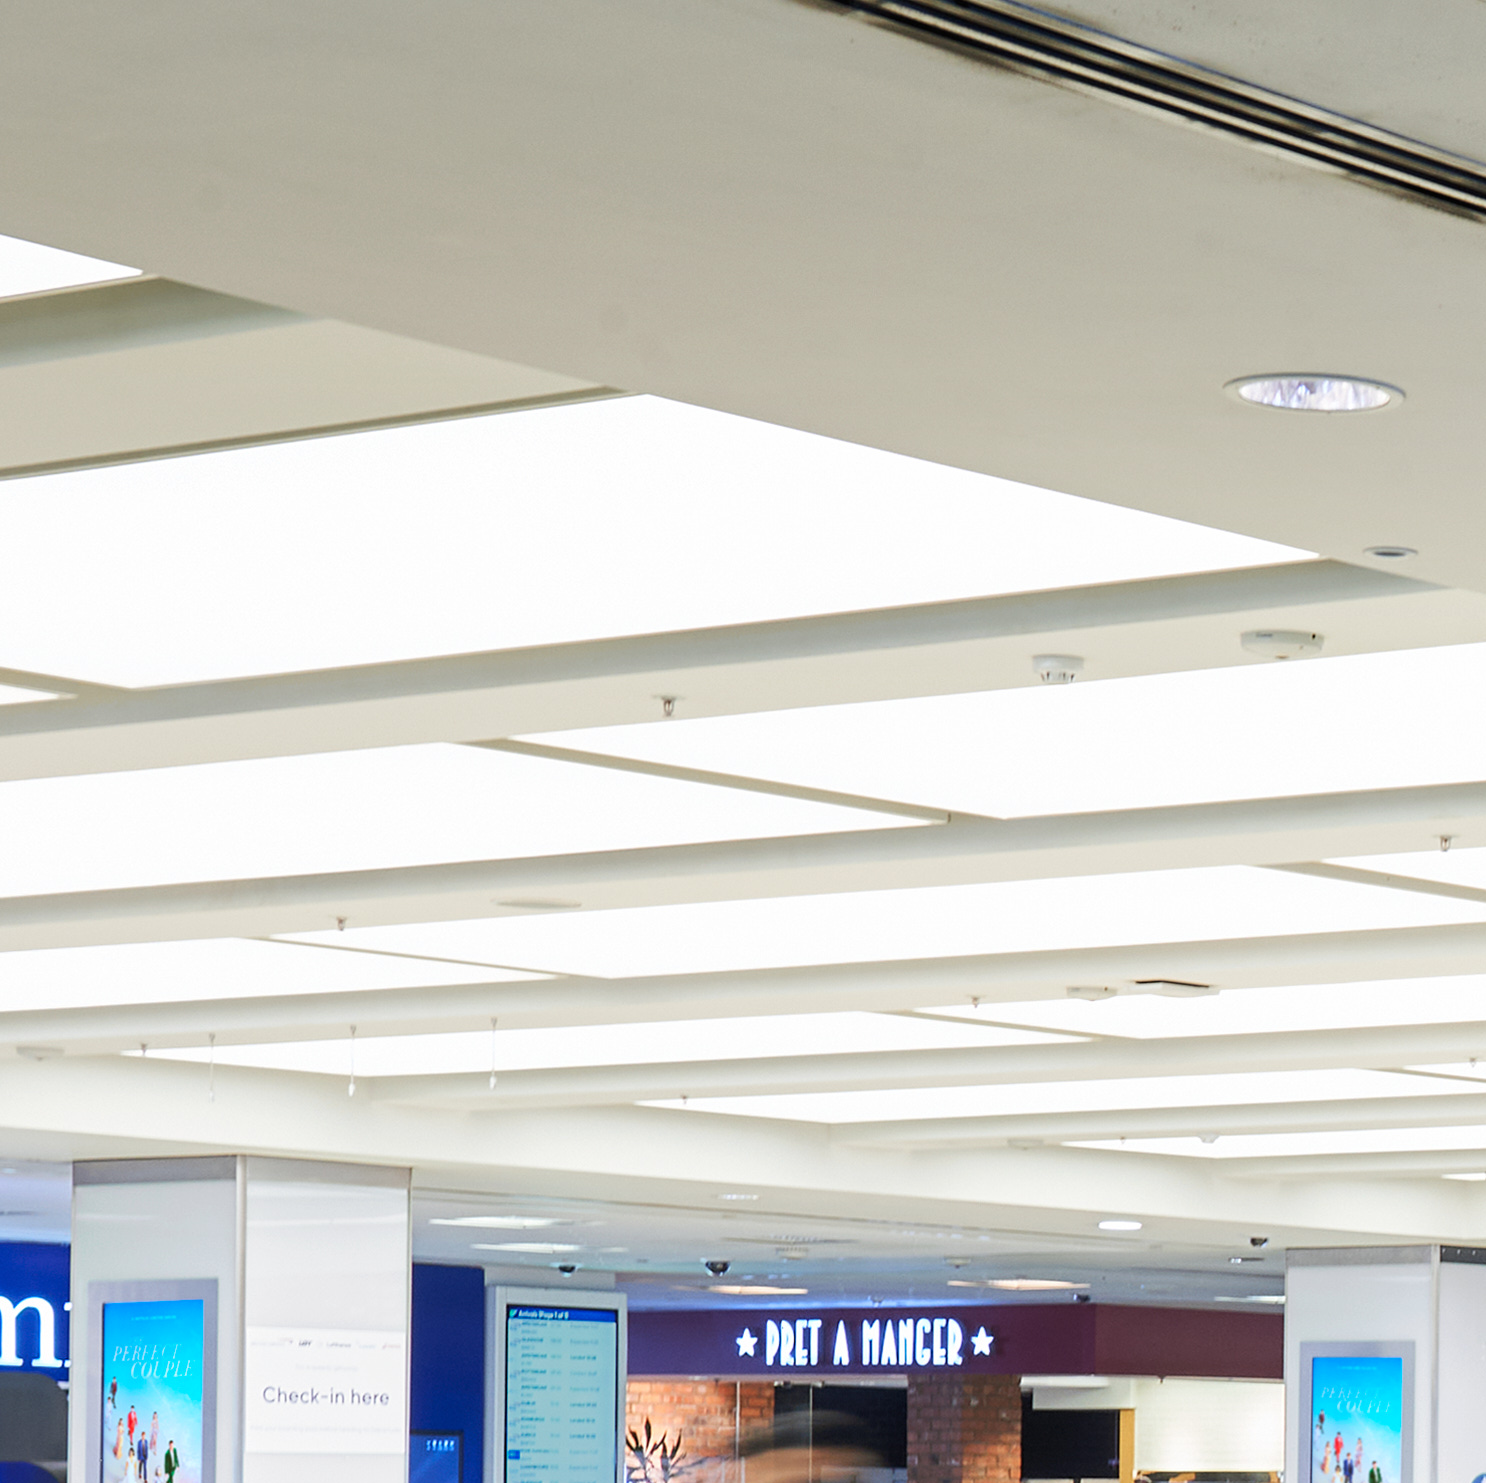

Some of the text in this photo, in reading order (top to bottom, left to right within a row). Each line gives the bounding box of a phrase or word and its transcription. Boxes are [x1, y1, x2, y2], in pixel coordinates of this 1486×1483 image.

[765, 1318, 964, 1366] PRET A MANGER
[113, 1344, 182, 1362] PERFECT
[131, 1359, 195, 1379] COUPLE
[262, 1386, 390, 1406] Check-in here
